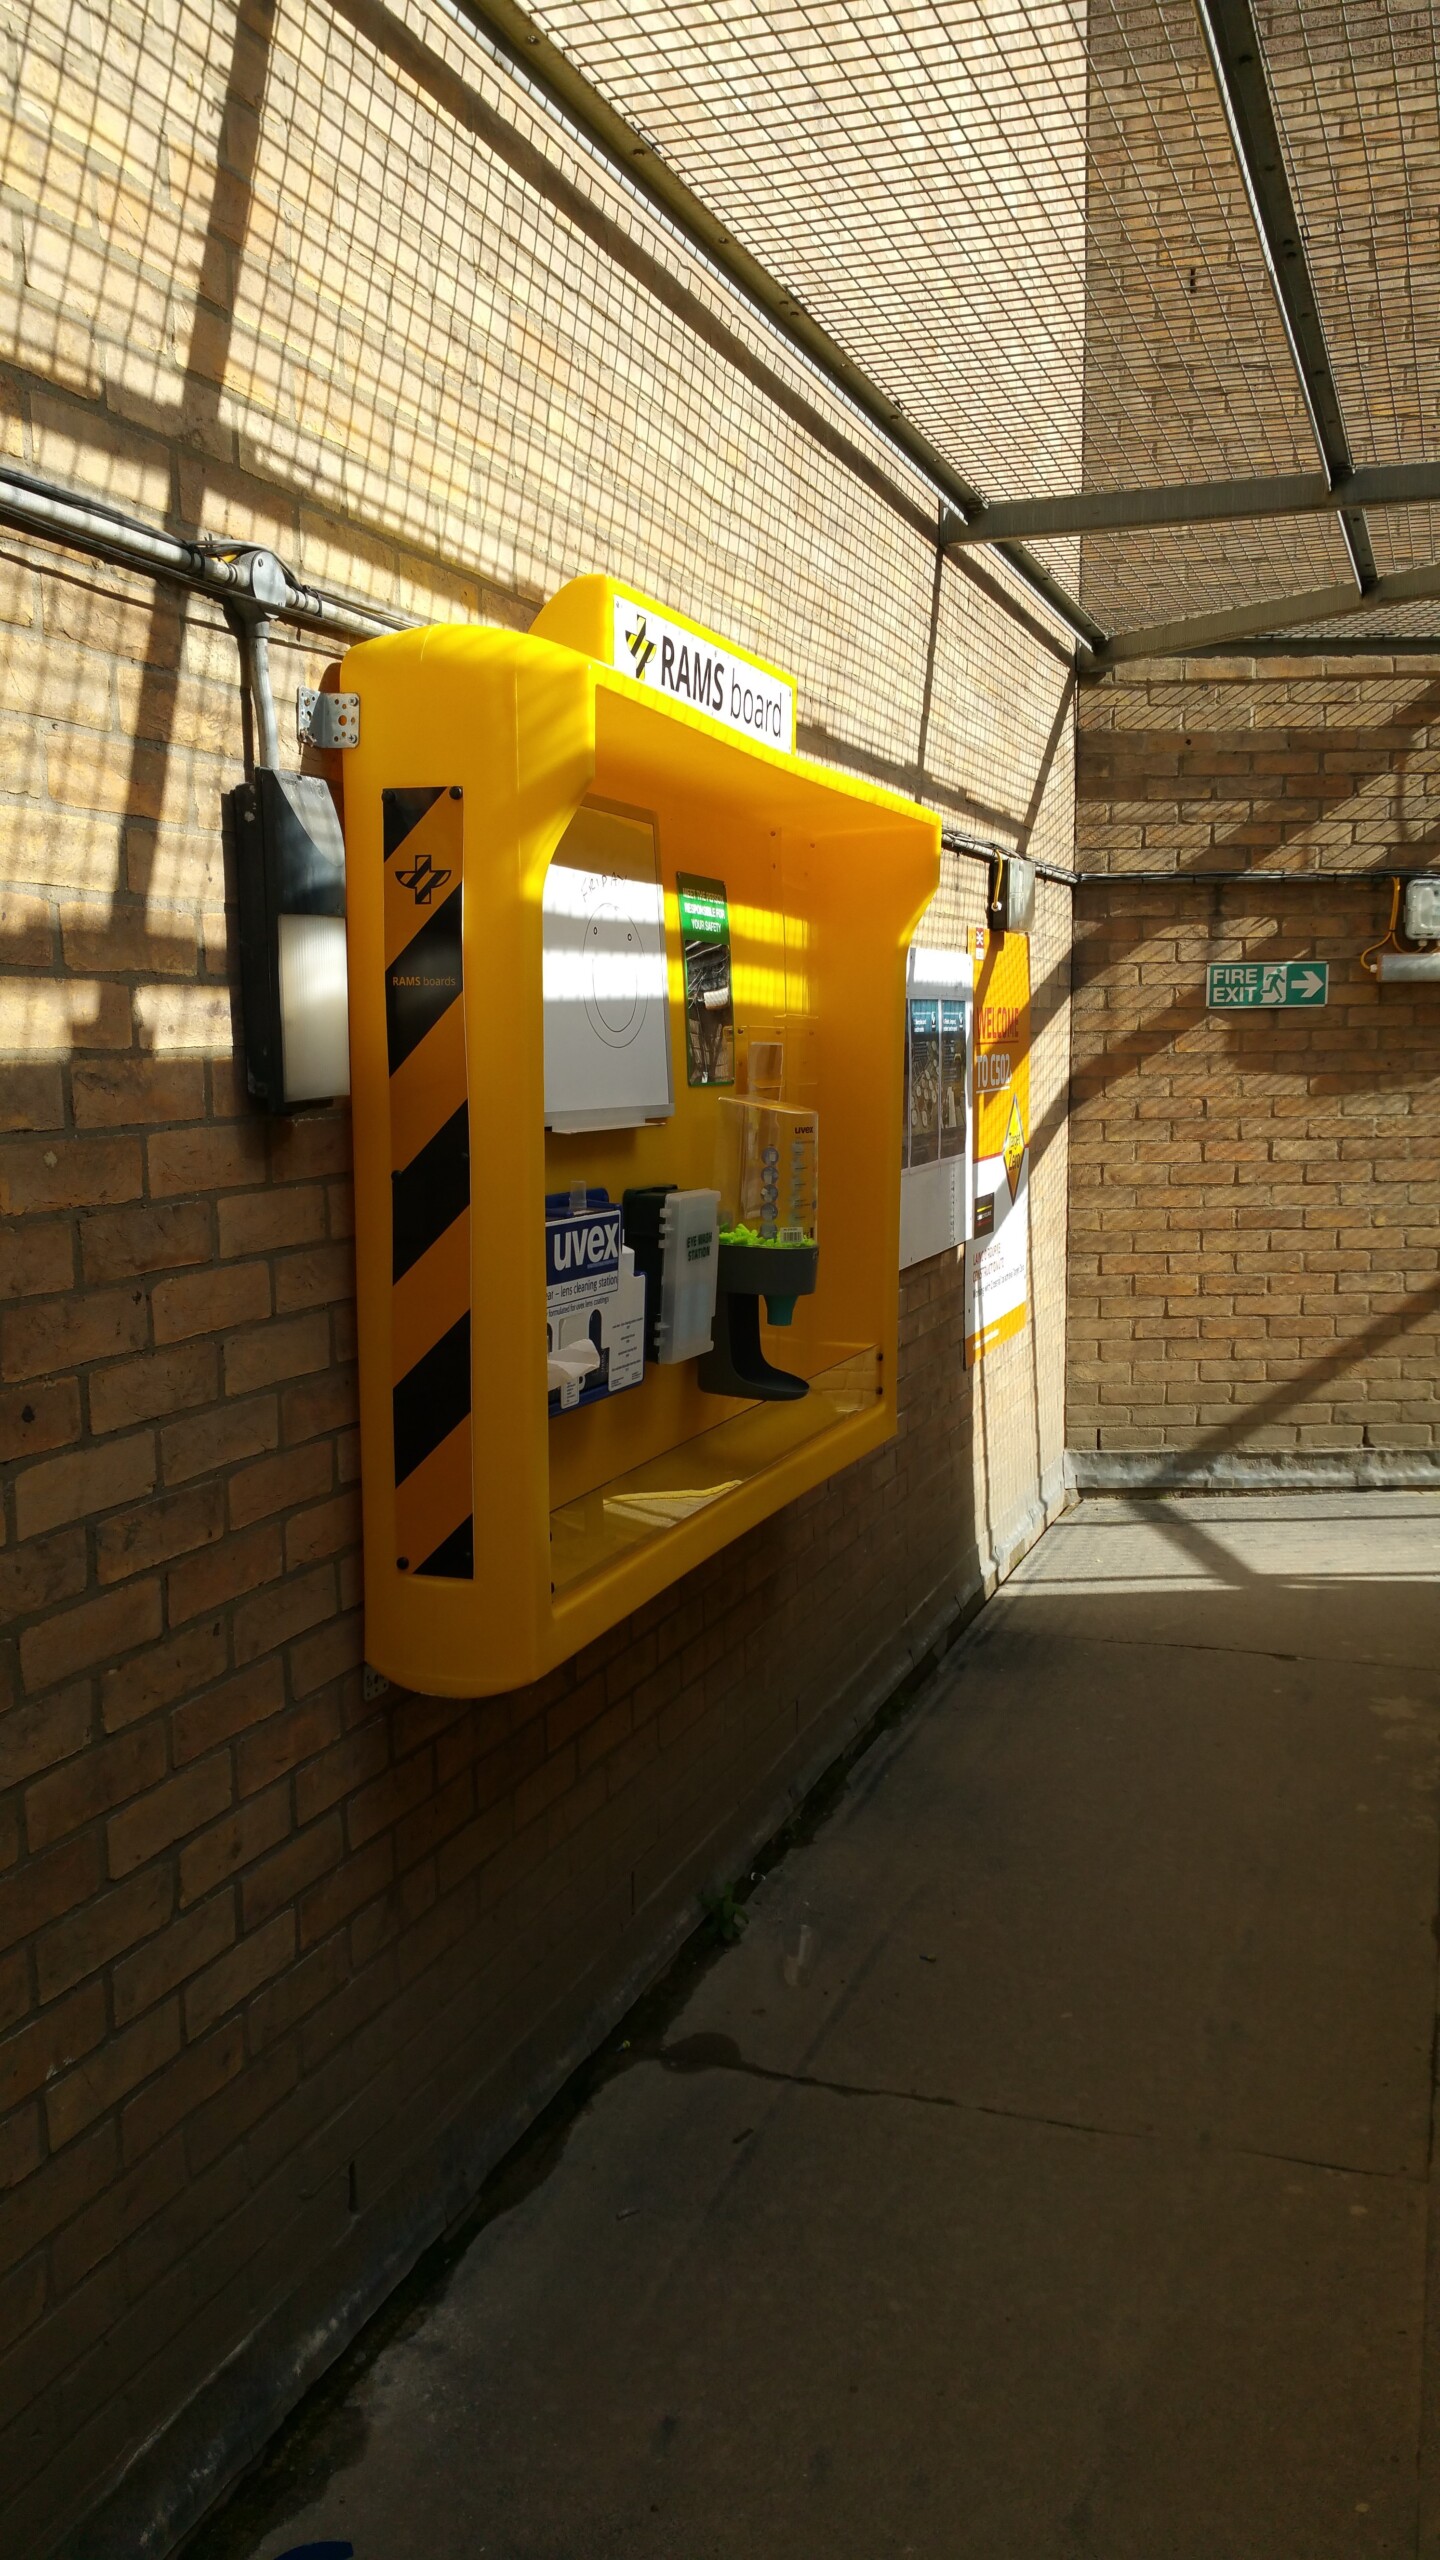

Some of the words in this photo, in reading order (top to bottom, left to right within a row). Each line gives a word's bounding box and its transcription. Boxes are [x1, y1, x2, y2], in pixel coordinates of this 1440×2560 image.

[661, 635, 725, 712] RAMS
[730, 668, 782, 738] board
[580, 871, 628, 903] FRIDAY
[682, 887, 696, 899] MEET
[696, 889, 706, 901] THE
[684, 902, 716, 917] RESPONSIBLE
[716, 908, 726, 920] FOR
[691, 918, 705, 930] YOUR
[705, 920, 722, 933] SAFETY
[392, 976, 421, 986] RAMS
[423, 976, 456, 986] boards
[1213, 968, 1258, 985] FIRE
[1213, 986, 1258, 1003] EXIT
[976, 1007, 1020, 1040] WELCOME
[976, 1055, 988, 1088] TO
[794, 1126, 814, 1134] uvex
[1008, 1131, 1021, 1151] Target
[1008, 1149, 1021, 1171] Zero
[554, 1222, 619, 1271] uvex
[687, 1235, 697, 1248] EYE
[697, 1231, 712, 1245] WASH
[687, 1246, 710, 1262] STATION
[560, 1285, 573, 1298] lens
[573, 1280, 597, 1293] cleaning
[598, 1275, 618, 1289] station
[548, 1304, 570, 1317] formulated
[585, 1299, 593, 1308] lens
[593, 1296, 610, 1307] coatings
